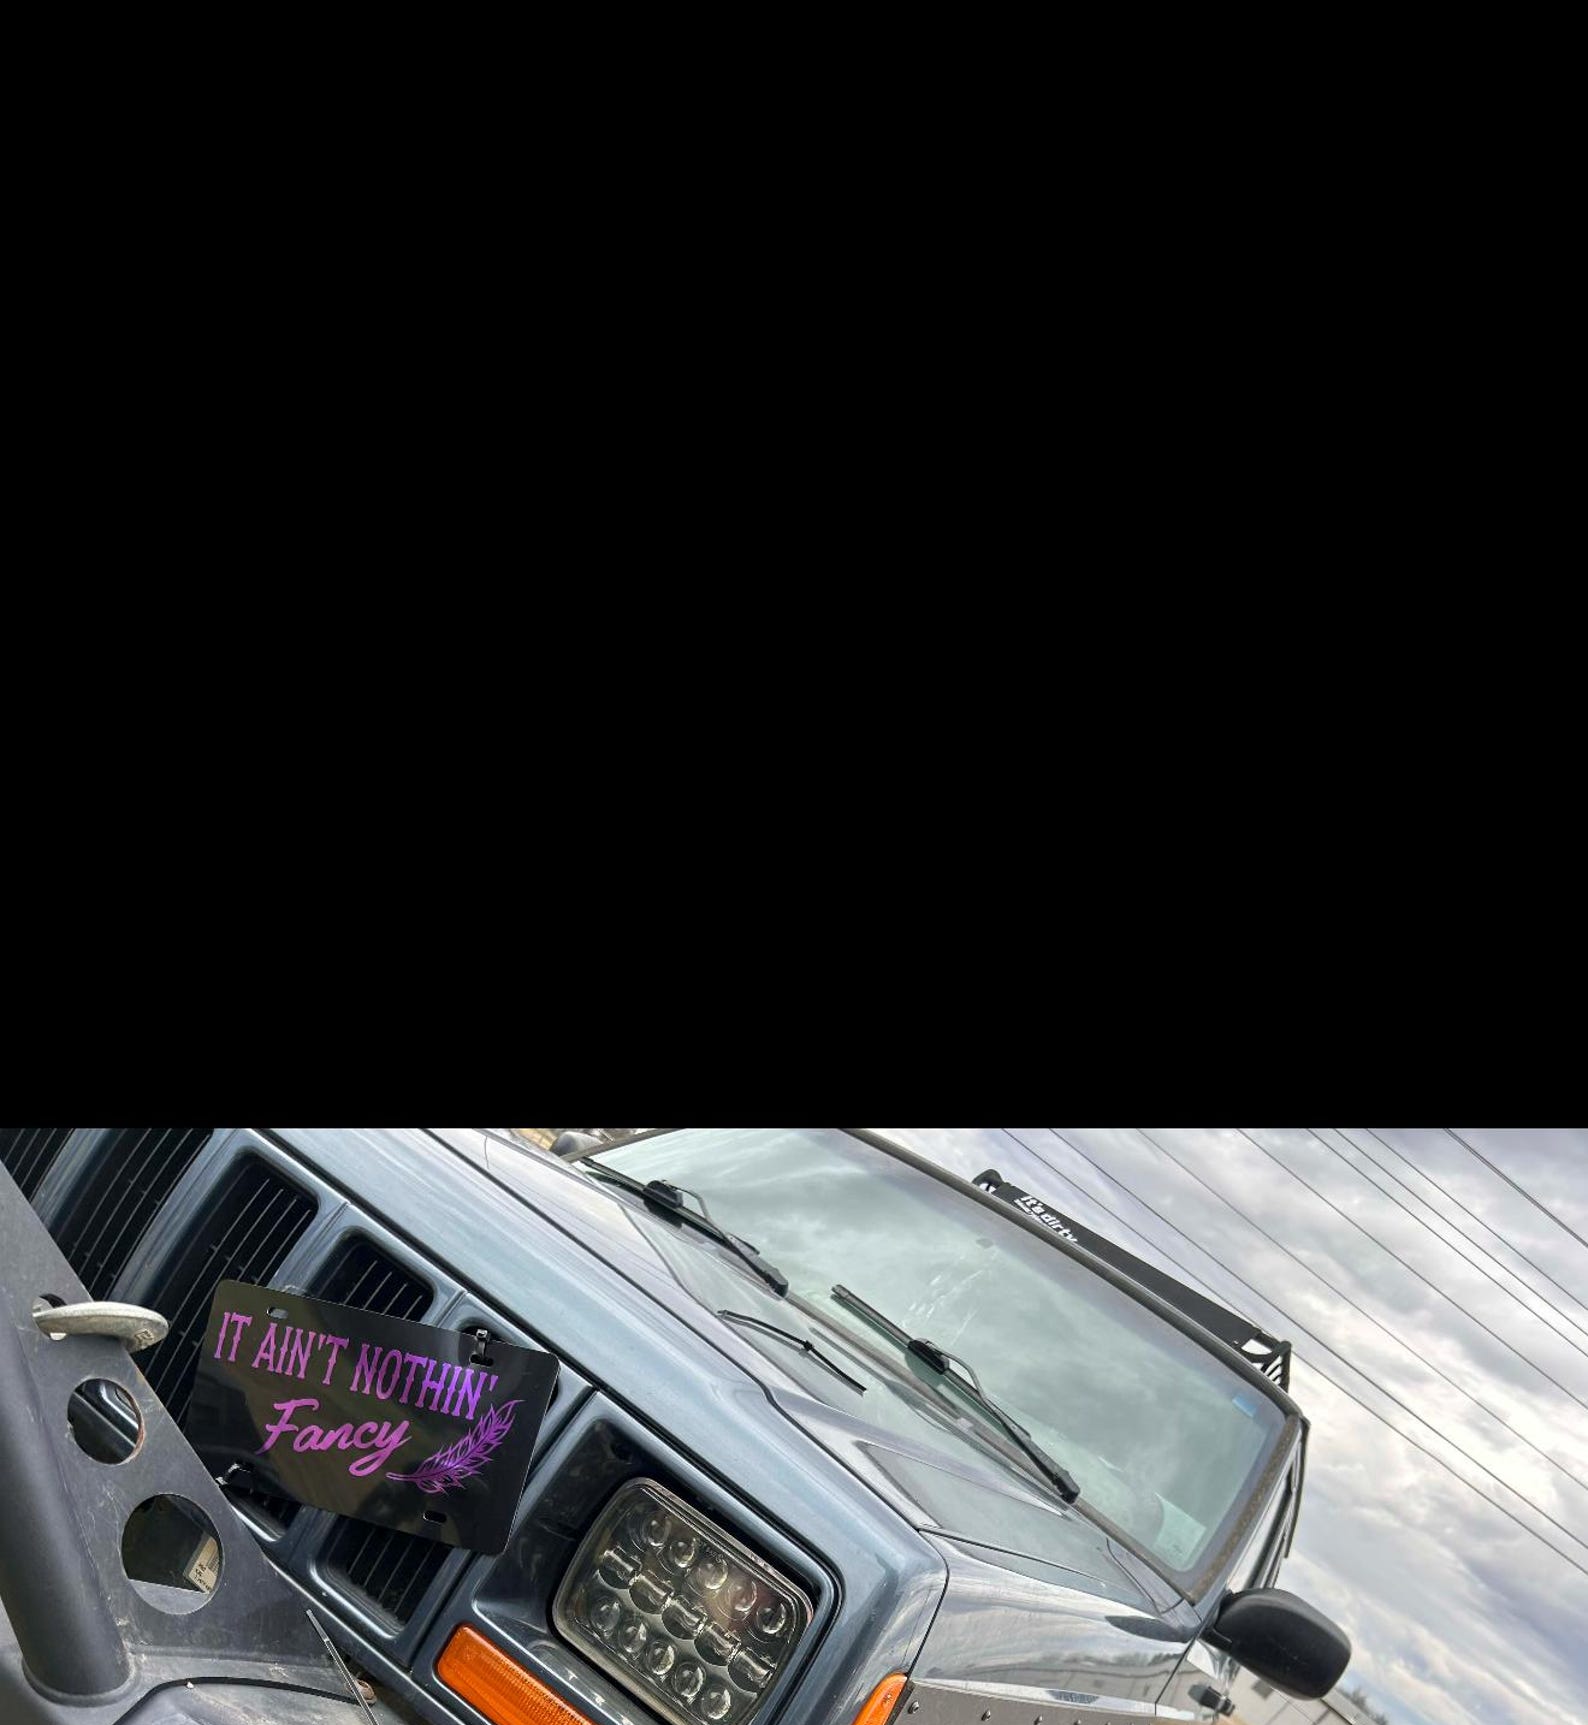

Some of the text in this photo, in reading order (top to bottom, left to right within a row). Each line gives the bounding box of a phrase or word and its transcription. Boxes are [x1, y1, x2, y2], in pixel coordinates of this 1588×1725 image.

[1039, 1213, 1078, 1242] dirty
[213, 1312, 499, 1421] IT AIN'T NOTHIN'
[255, 1398, 412, 1477] Fancy
